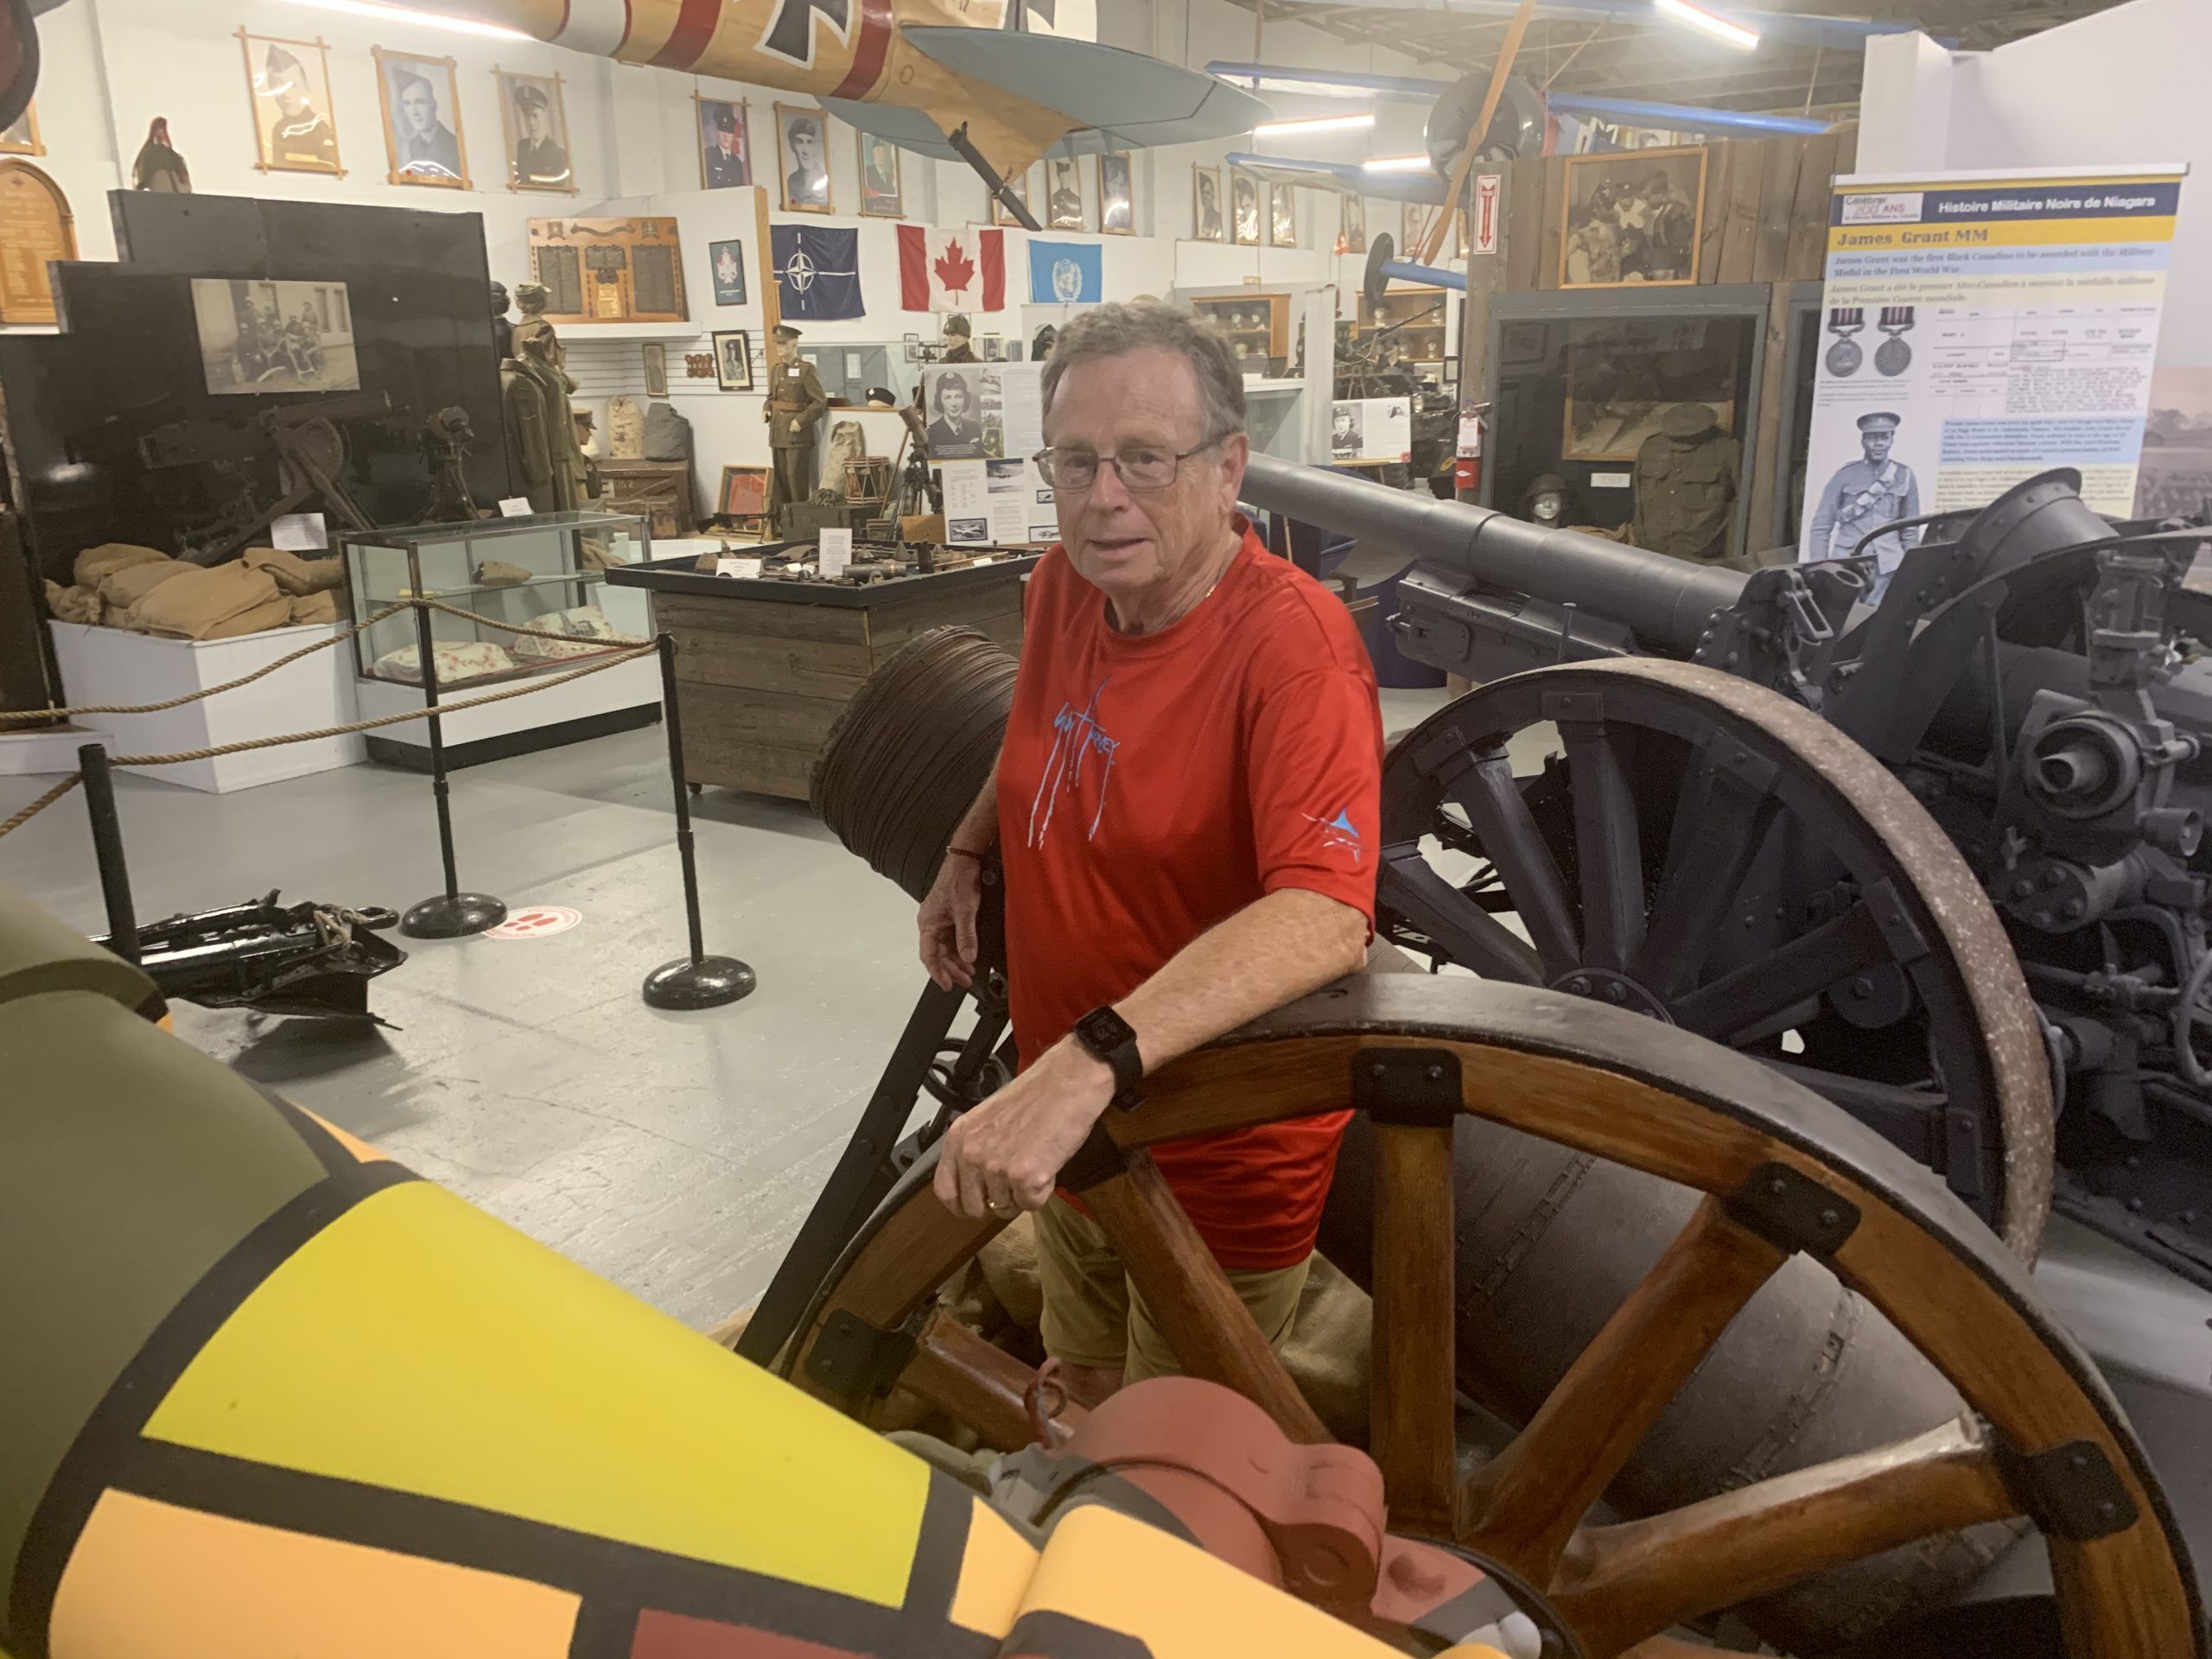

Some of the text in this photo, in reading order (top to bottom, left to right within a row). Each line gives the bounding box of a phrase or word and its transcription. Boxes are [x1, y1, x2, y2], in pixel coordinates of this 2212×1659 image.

[1938, 195, 2156, 213] Histoire Militaire Noire de Niagara
[1837, 229, 1988, 246] James Grant MM
[1865, 255, 1889, 264] Grant
[1910, 254, 1924, 263] the
[1926, 253, 1943, 262] first
[1947, 252, 1969, 261] Black
[1972, 251, 2013, 260] Canadian
[1834, 268, 1860, 277] Medal
[1873, 267, 1888, 276] the
[1890, 266, 1910, 275] First
[1912, 265, 1939, 274] World
[1830, 284, 1858, 293] James
[1859, 283, 1885, 292] Grant
[1892, 295, 1922, 303] Guerre
